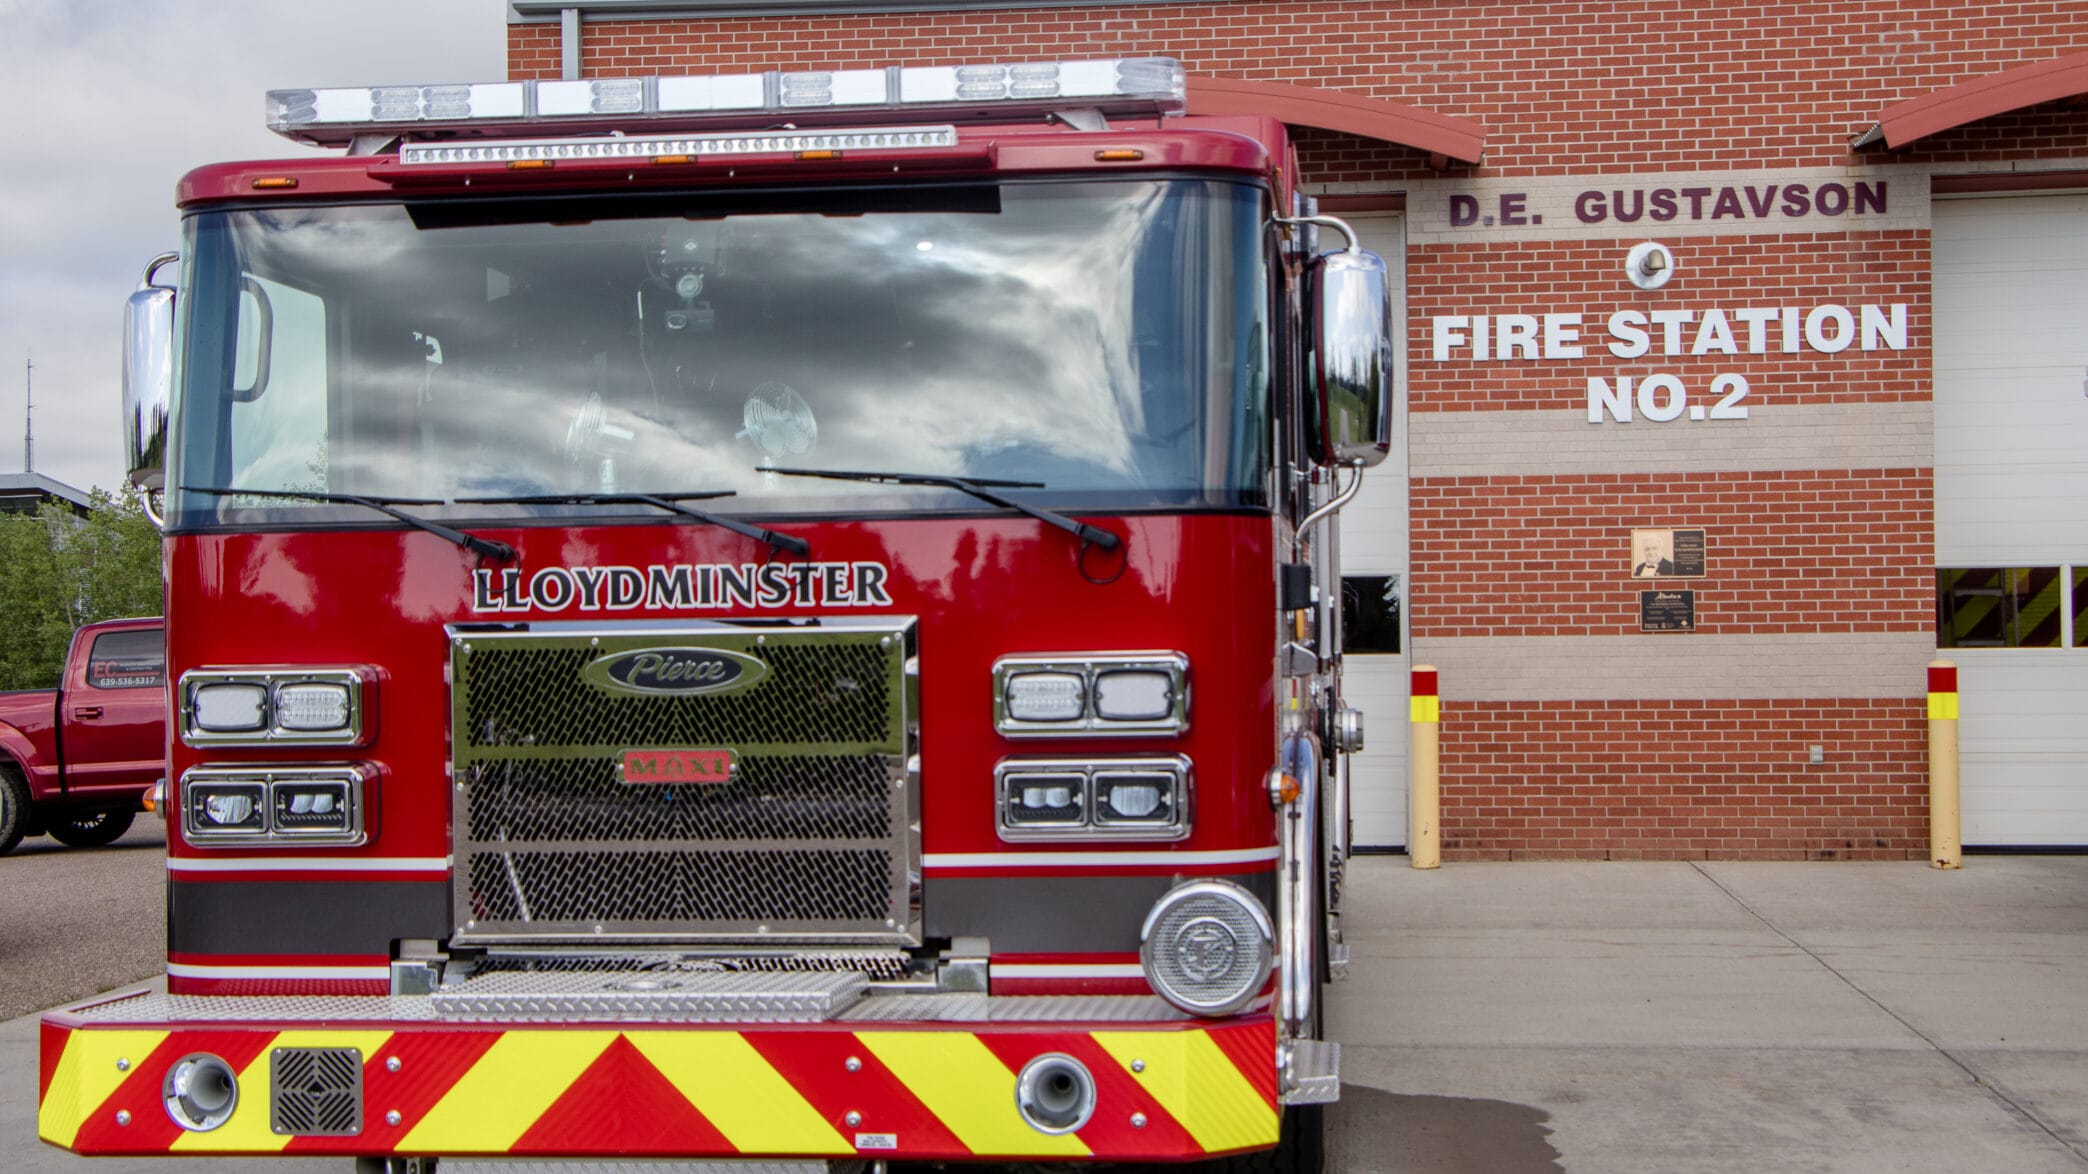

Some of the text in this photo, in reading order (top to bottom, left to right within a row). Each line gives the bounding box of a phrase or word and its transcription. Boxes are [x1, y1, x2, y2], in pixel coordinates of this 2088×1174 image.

[1450, 181, 1888, 227] D.E. GUSTAVSON
[1432, 302, 1908, 362] FIRE STATION
[1587, 372, 1750, 424] NO.2
[473, 562, 893, 613] LLOYDMINSTER
[626, 652, 727, 687] Pierce
[629, 756, 724, 777] MAXI
